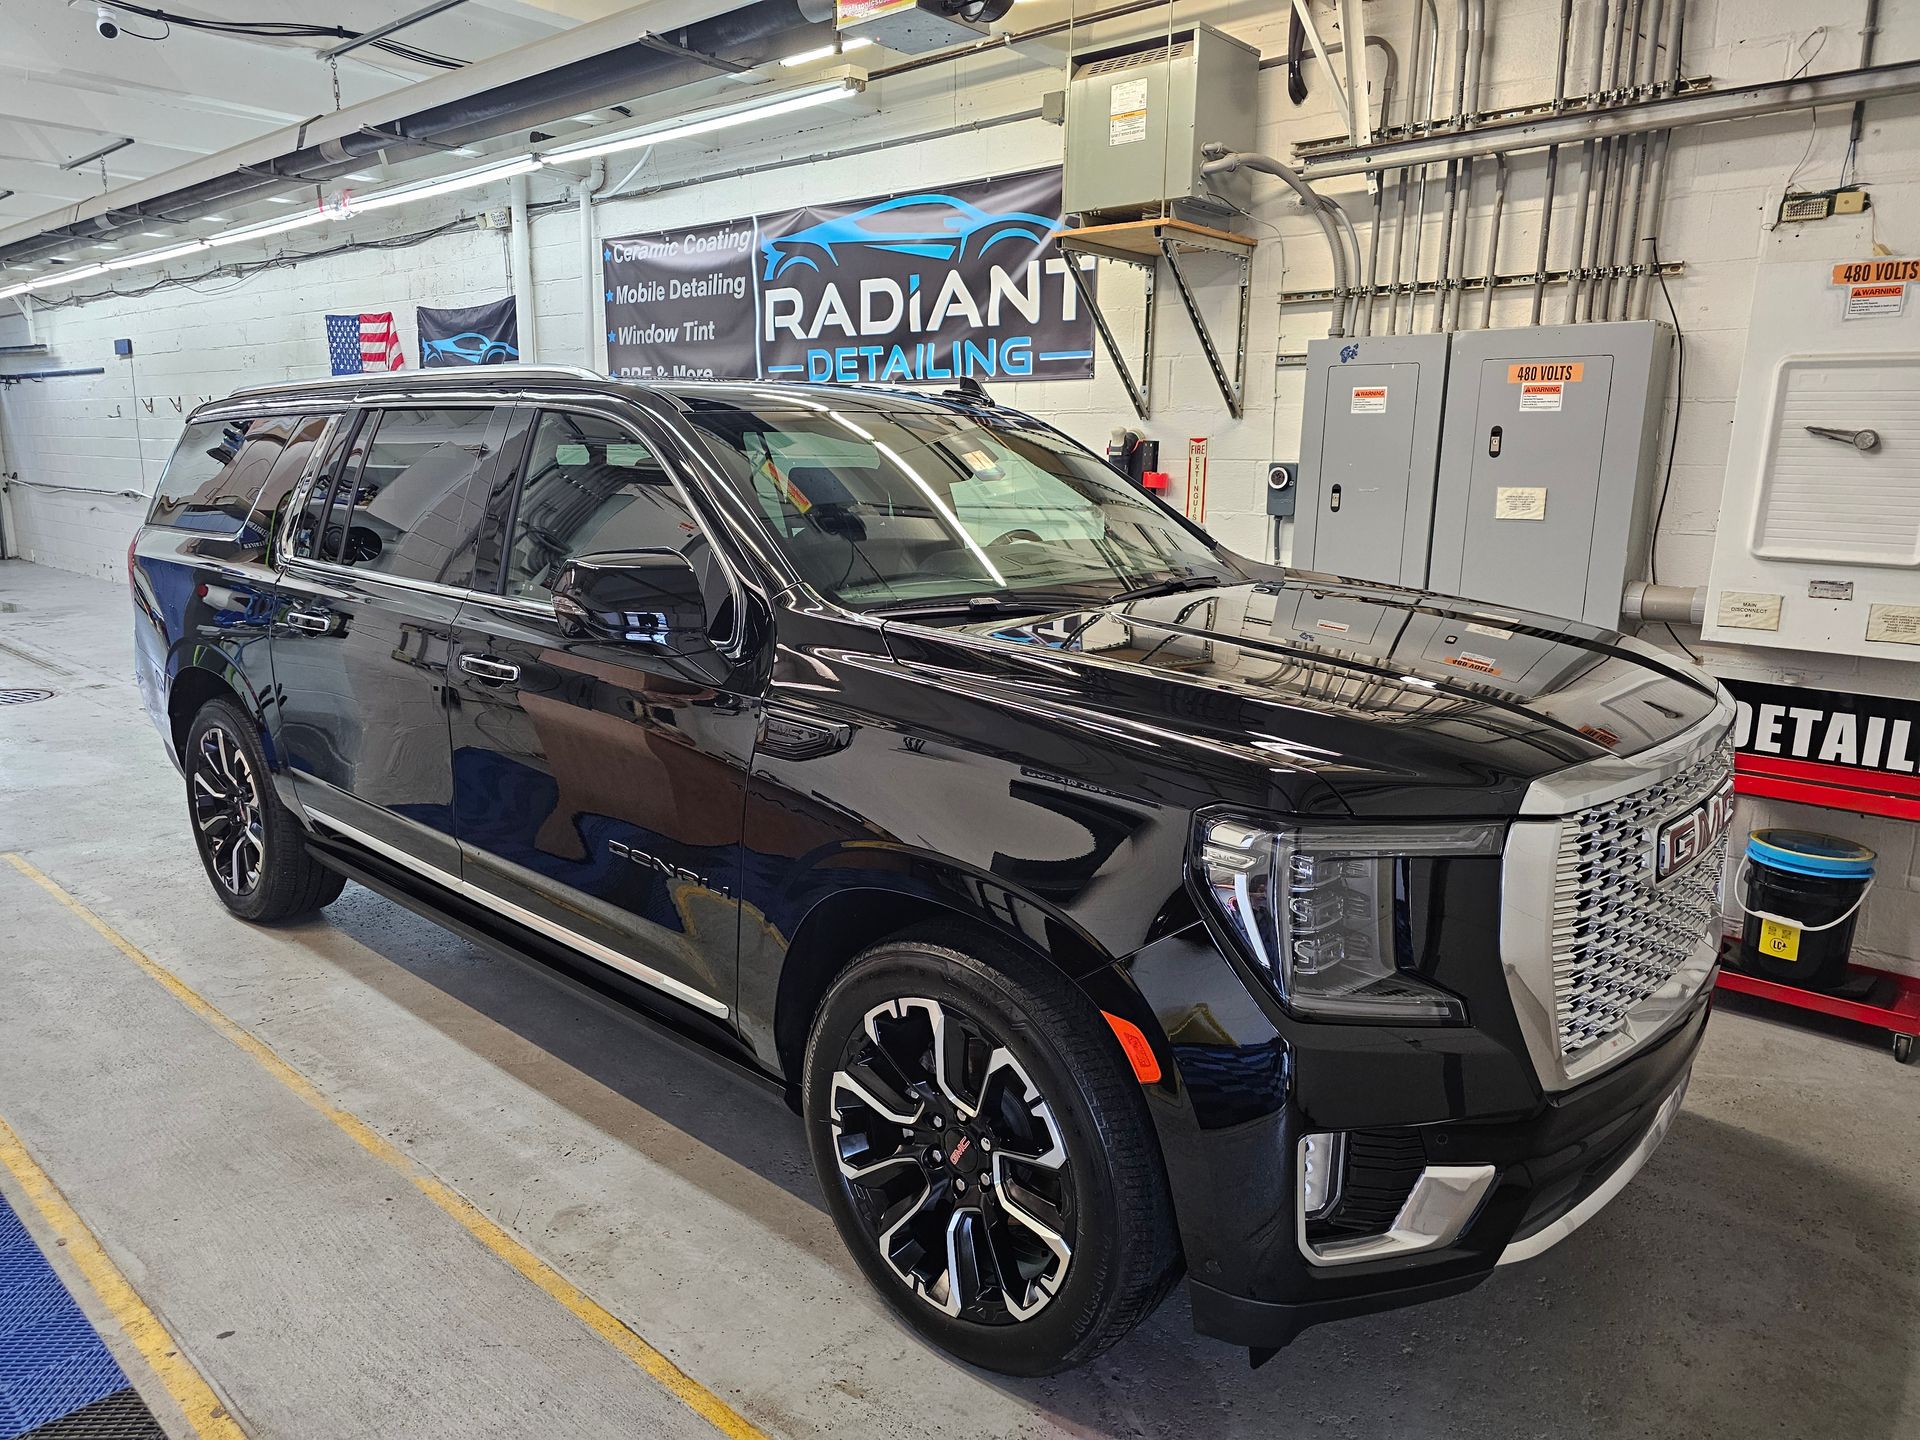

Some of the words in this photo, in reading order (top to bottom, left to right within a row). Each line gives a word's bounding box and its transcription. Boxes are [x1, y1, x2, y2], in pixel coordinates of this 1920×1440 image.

[613, 237, 679, 263] Ceramic
[683, 228, 751, 253] Coating
[1844, 264, 1871, 282] 480
[1876, 261, 1919, 281] VOLTS
[616, 281, 665, 305] Mobile
[670, 273, 746, 299] Detailing
[764, 254, 1096, 343] RADIANT
[1862, 287, 1901, 296] WARNING
[618, 324, 679, 345] Window
[683, 321, 715, 341] Tint
[673, 365, 713, 377] More
[807, 336, 1033, 383] DETAILING
[1517, 366, 1537, 381] 480
[1540, 365, 1572, 381] VOLTS
[1191, 444, 1206, 455] FIRE
[1730, 606, 1768, 614] DISCONNECT
[1735, 700, 1920, 773] DETAIL
[1664, 779, 1734, 877] GMC
[949, 1135, 971, 1165] GMC
